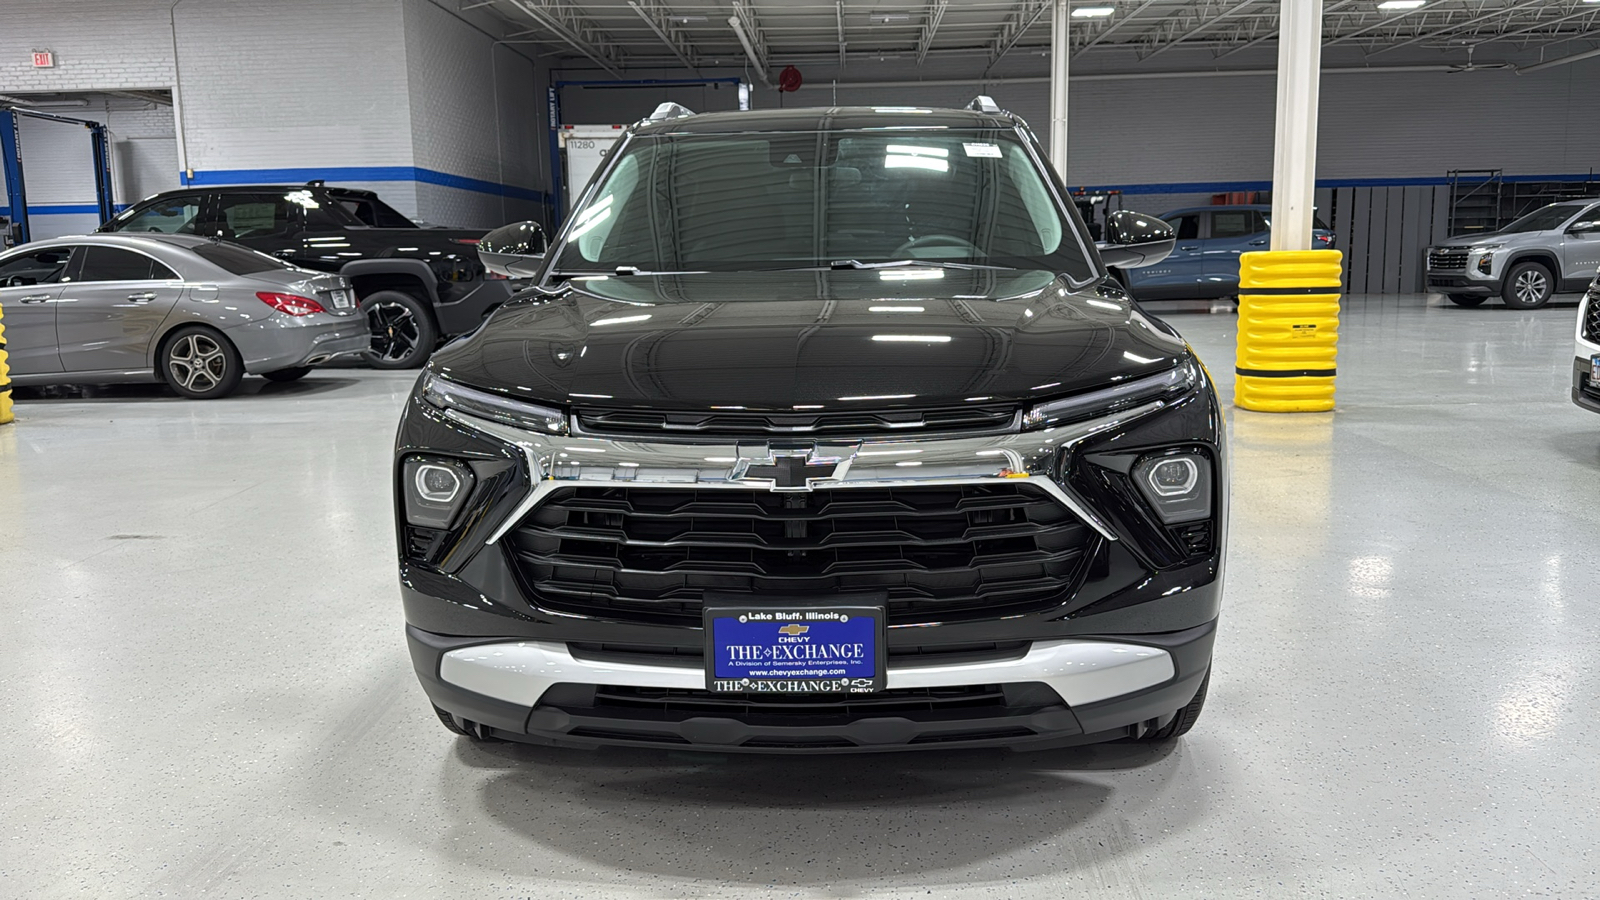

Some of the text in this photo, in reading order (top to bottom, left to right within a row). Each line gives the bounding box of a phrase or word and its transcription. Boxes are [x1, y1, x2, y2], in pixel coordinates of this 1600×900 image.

[34, 53, 49, 66] EXIT
[570, 141, 595, 149] 11280
[748, 612, 839, 620] Lake Bluff, Illinois
[726, 643, 864, 660] THE EXCHANGE
[773, 660, 806, 668] Semersky
[749, 669, 846, 677] www.chevyexchange.com
[713, 680, 842, 692] THE EXCHANGE
